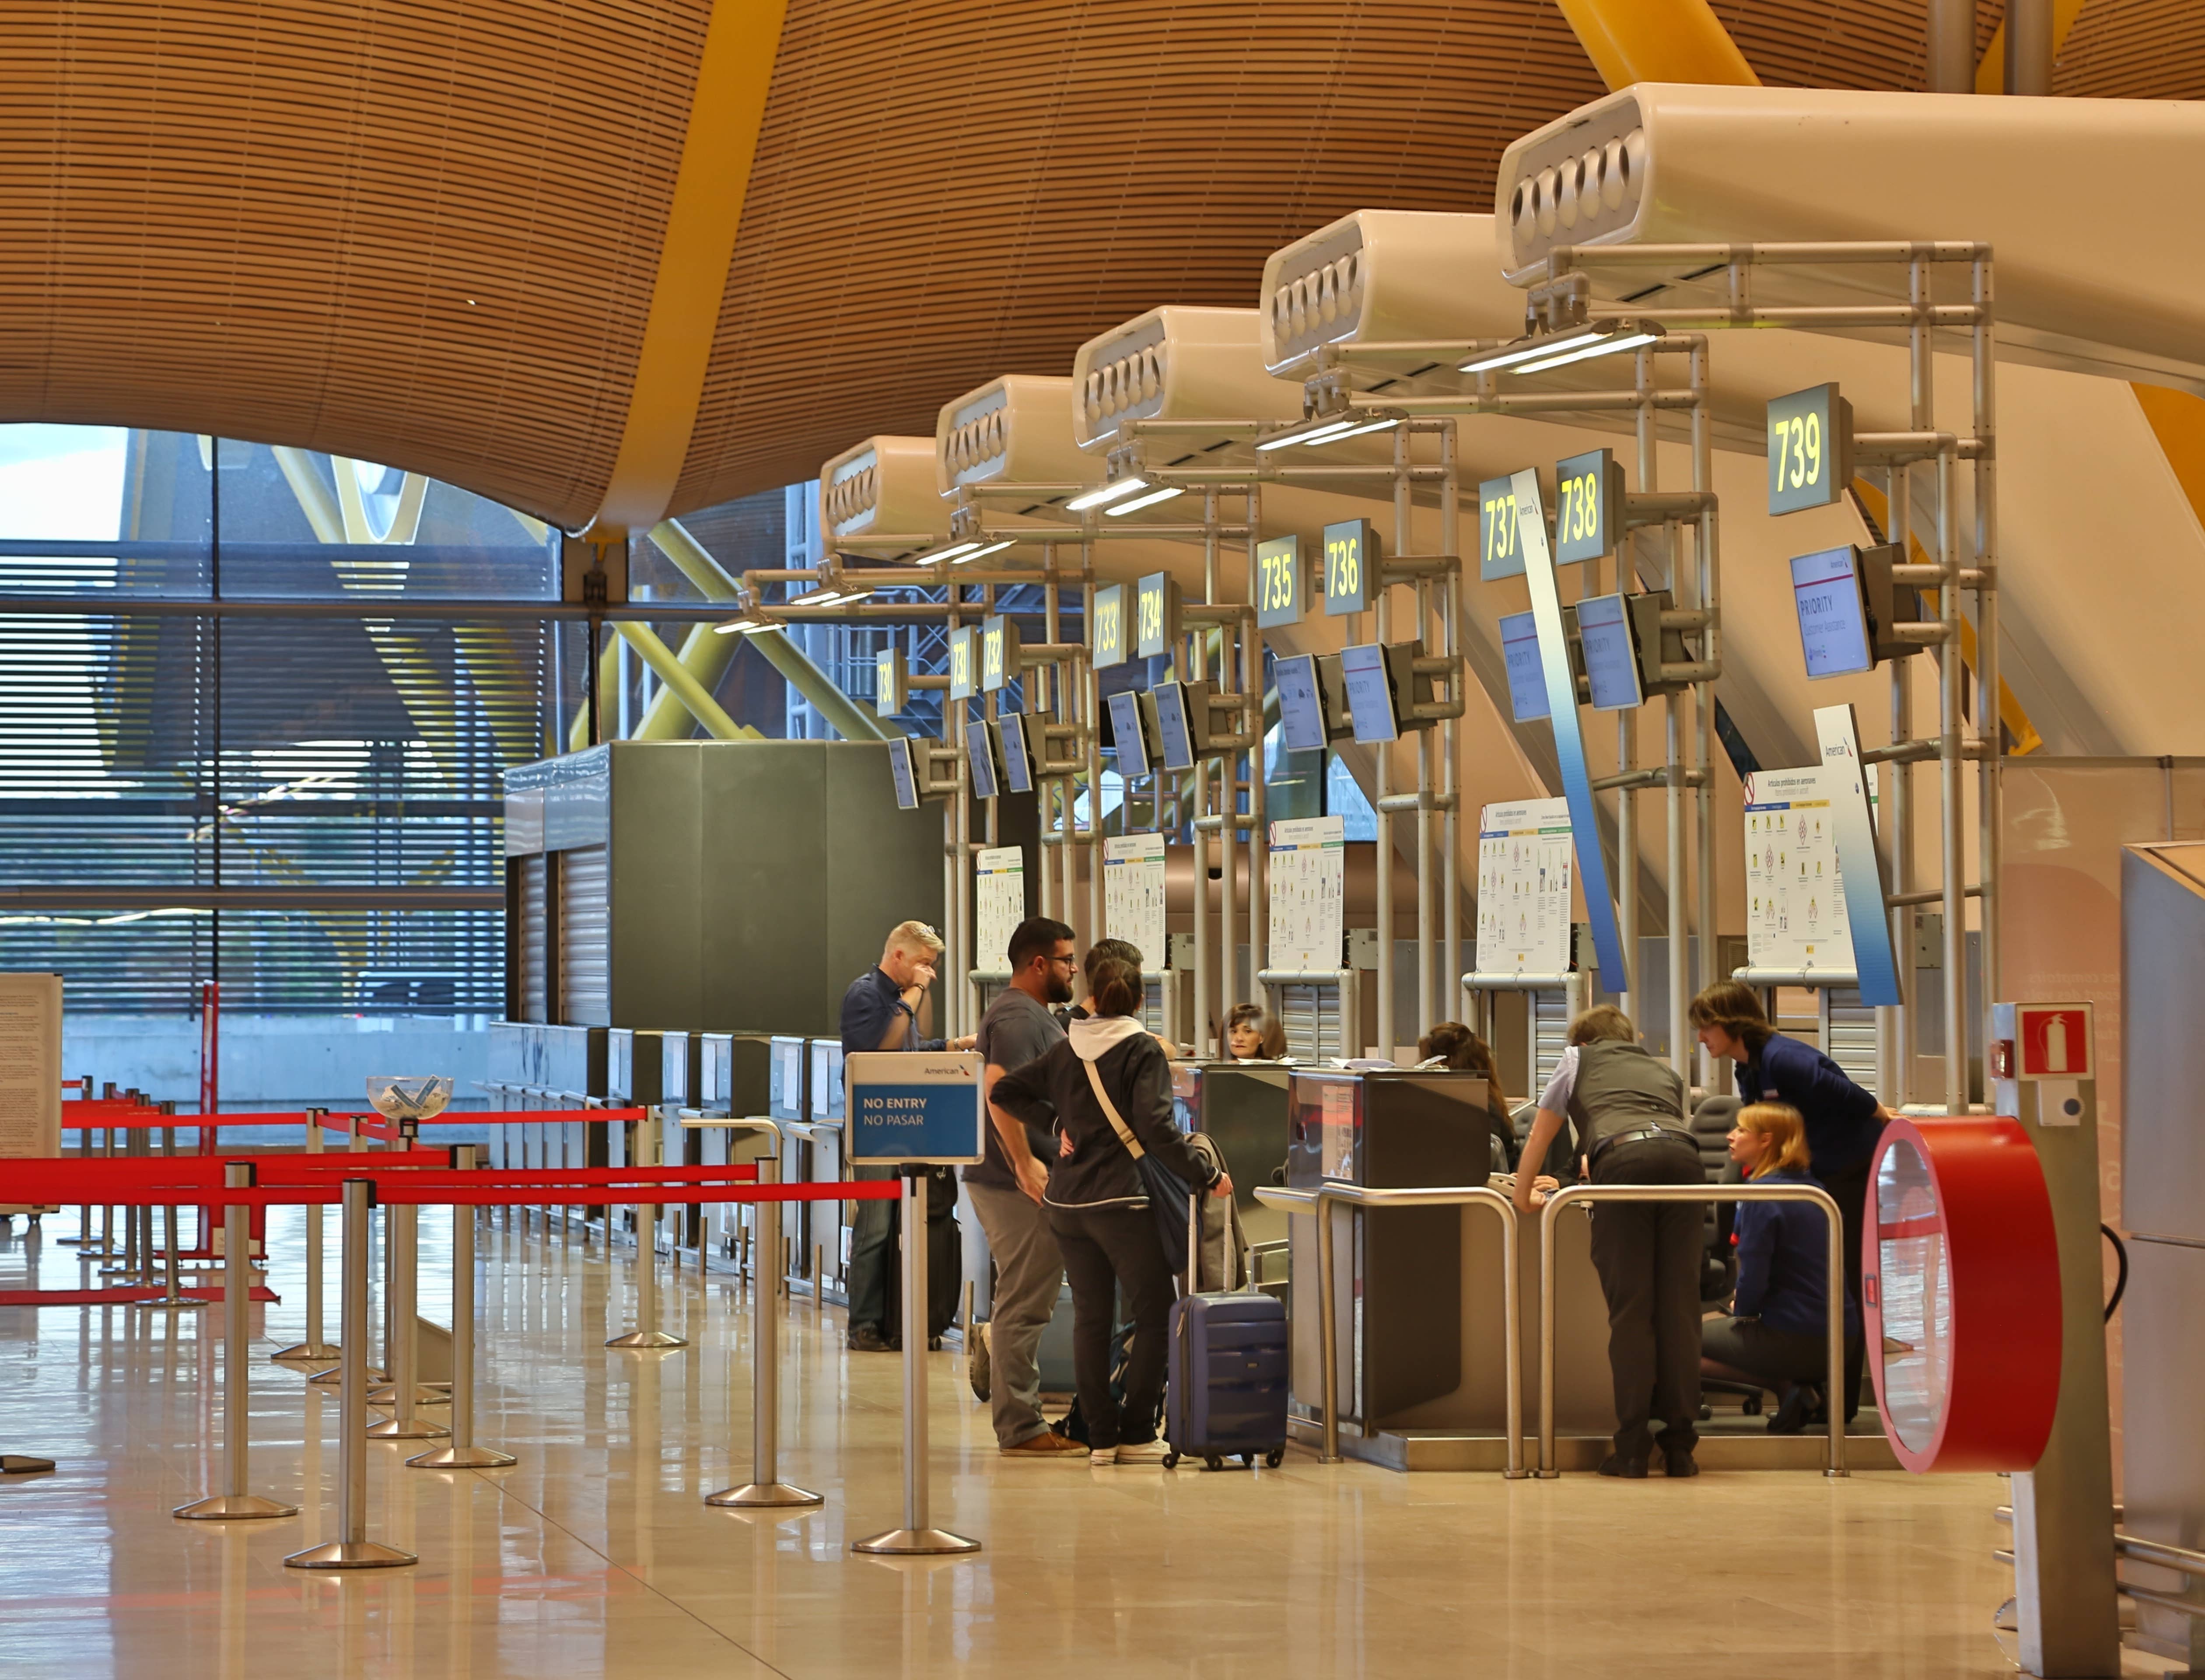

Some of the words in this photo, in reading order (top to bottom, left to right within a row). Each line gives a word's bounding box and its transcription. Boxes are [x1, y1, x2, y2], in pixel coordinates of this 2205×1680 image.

[1775, 412, 1820, 492] 739
[1485, 494, 1517, 561] 737
[1561, 472, 1597, 544] 738
[1262, 553, 1292, 612] 735
[1328, 538, 1358, 598] 736
[1096, 602, 1116, 654] 733
[1141, 588, 1161, 642] 734
[1800, 594, 1833, 616] PRIORITY
[953, 640, 968, 686] 731
[986, 629, 1001, 677] 732
[878, 661, 892, 704] 730
[1825, 744, 1846, 757] American
[924, 1067, 959, 1075] American
[863, 1098, 884, 1109] NO
[886, 1098, 927, 1109] ENTRY
[864, 1114, 883, 1126] NO
[886, 1114, 924, 1126] PASAR
